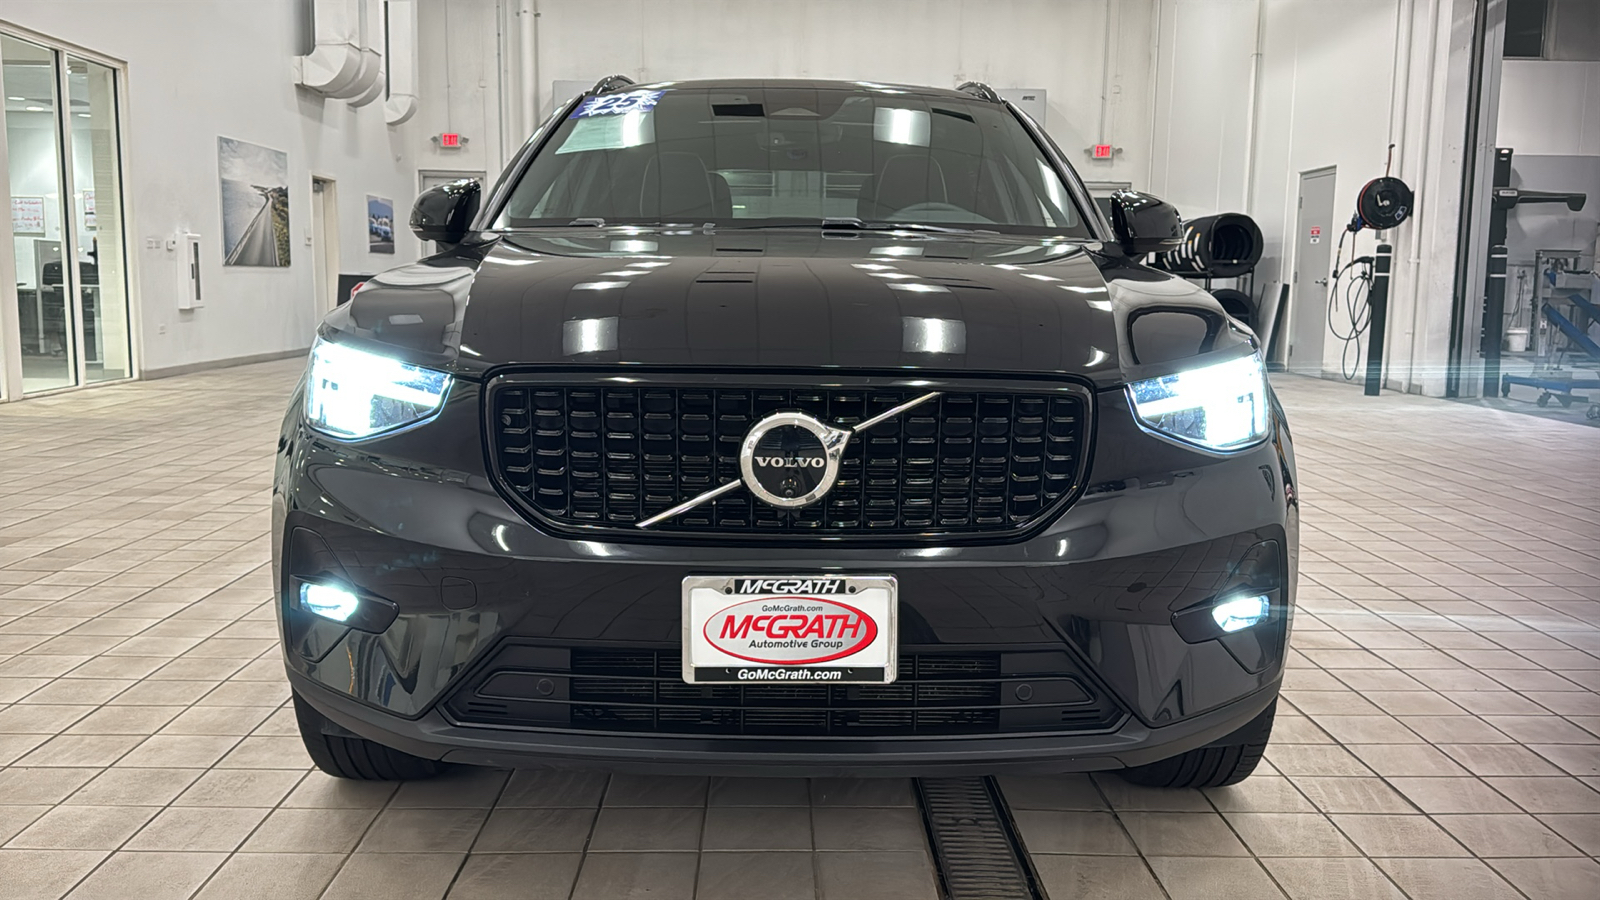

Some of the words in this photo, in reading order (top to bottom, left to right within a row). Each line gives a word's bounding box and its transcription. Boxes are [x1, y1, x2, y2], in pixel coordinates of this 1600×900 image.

[593, 96, 642, 111] 25
[754, 456, 825, 468] VOLVO
[761, 604, 823, 613] GoMcGrath.com
[748, 639, 808, 649] Automotive
[810, 639, 843, 650] Group
[737, 668, 842, 681] GoMcGrath.com
